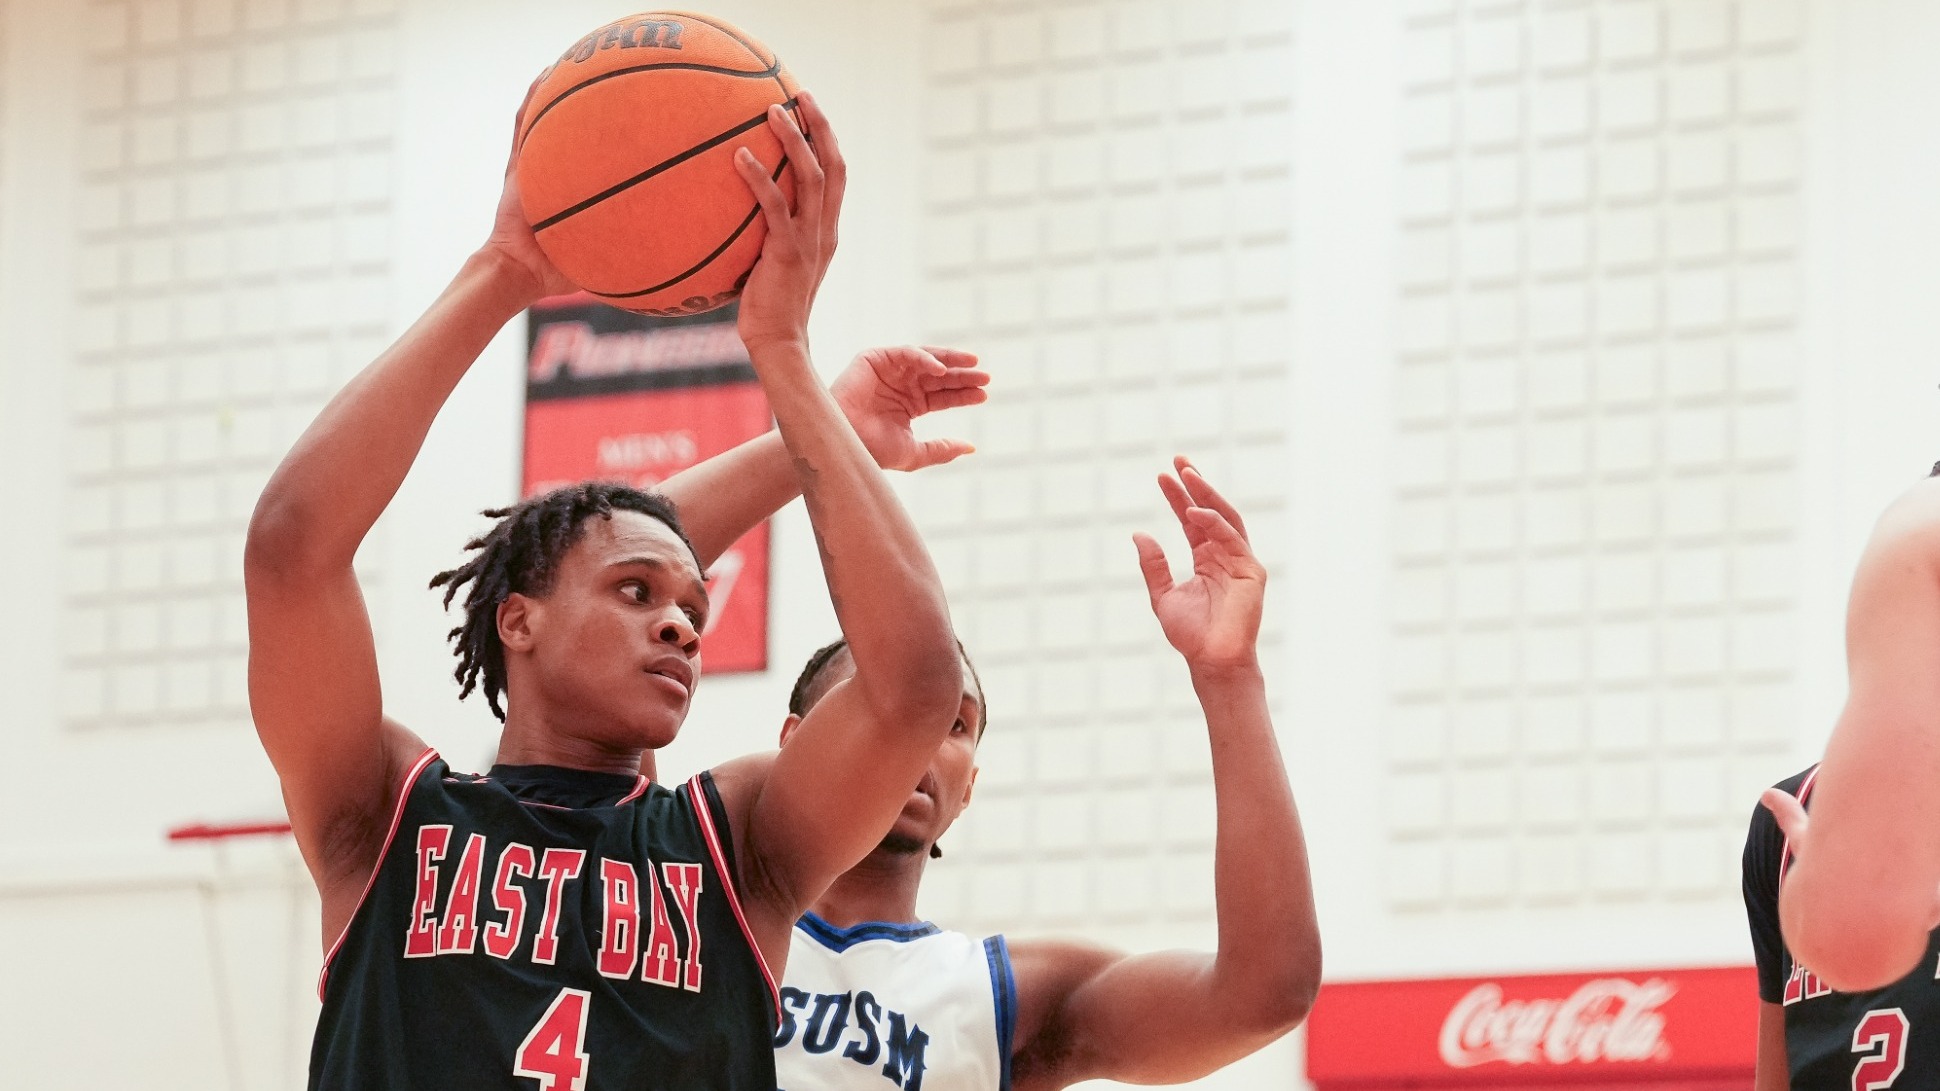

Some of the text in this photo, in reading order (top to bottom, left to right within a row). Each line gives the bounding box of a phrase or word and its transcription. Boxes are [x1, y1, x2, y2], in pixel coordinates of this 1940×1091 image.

[403, 824, 702, 992] EAST BAY
[513, 987, 591, 1091] 4
[774, 986, 930, 1091] SUSM
[1851, 1007, 1910, 1091] 2
